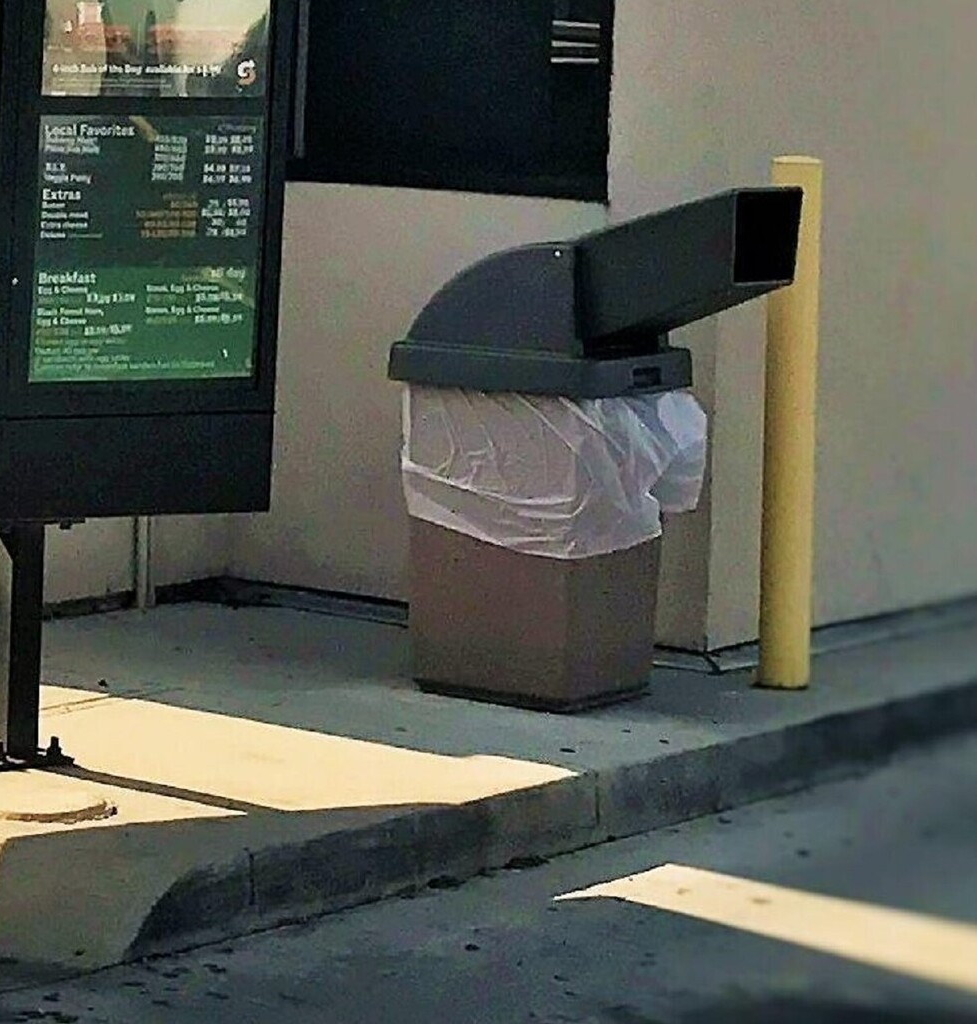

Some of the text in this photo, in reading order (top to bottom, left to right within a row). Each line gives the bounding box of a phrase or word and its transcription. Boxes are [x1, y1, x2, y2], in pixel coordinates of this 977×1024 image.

[44, 123, 136, 136] Local Favorites
[42, 188, 81, 201] Extras
[38, 271, 97, 285] Breakfast
